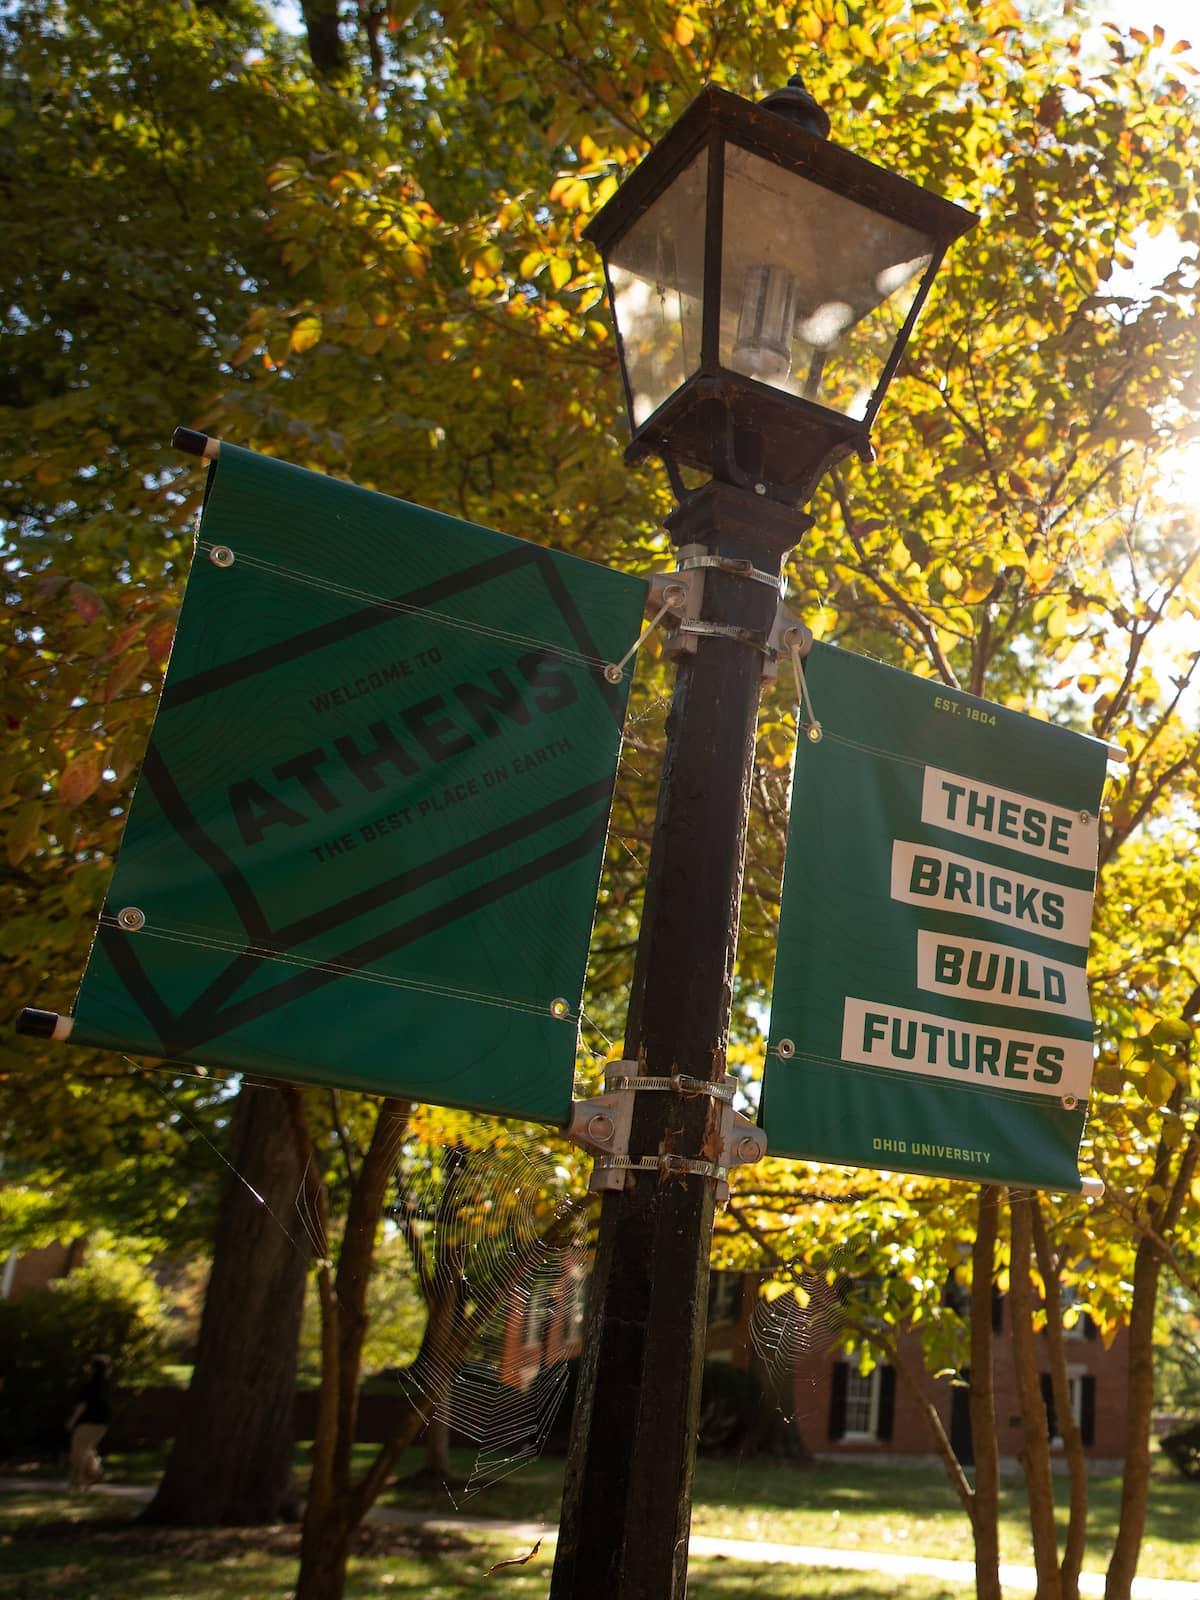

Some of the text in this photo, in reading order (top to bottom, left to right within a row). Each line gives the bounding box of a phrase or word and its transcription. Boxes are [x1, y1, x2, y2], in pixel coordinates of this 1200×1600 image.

[310, 647, 444, 714] WELCOME TO
[934, 697, 996, 727] EST. 1804
[226, 648, 579, 846] ATHENS
[310, 738, 572, 864] THE BEST PLACE ON EARTH
[941, 781, 1073, 855] THESE
[909, 855, 1065, 930] BRICKS
[934, 944, 1067, 1005] BUILD
[862, 1012, 1065, 1085] FUTURES
[872, 1138, 992, 1164] OHIO UNIVERSITY
